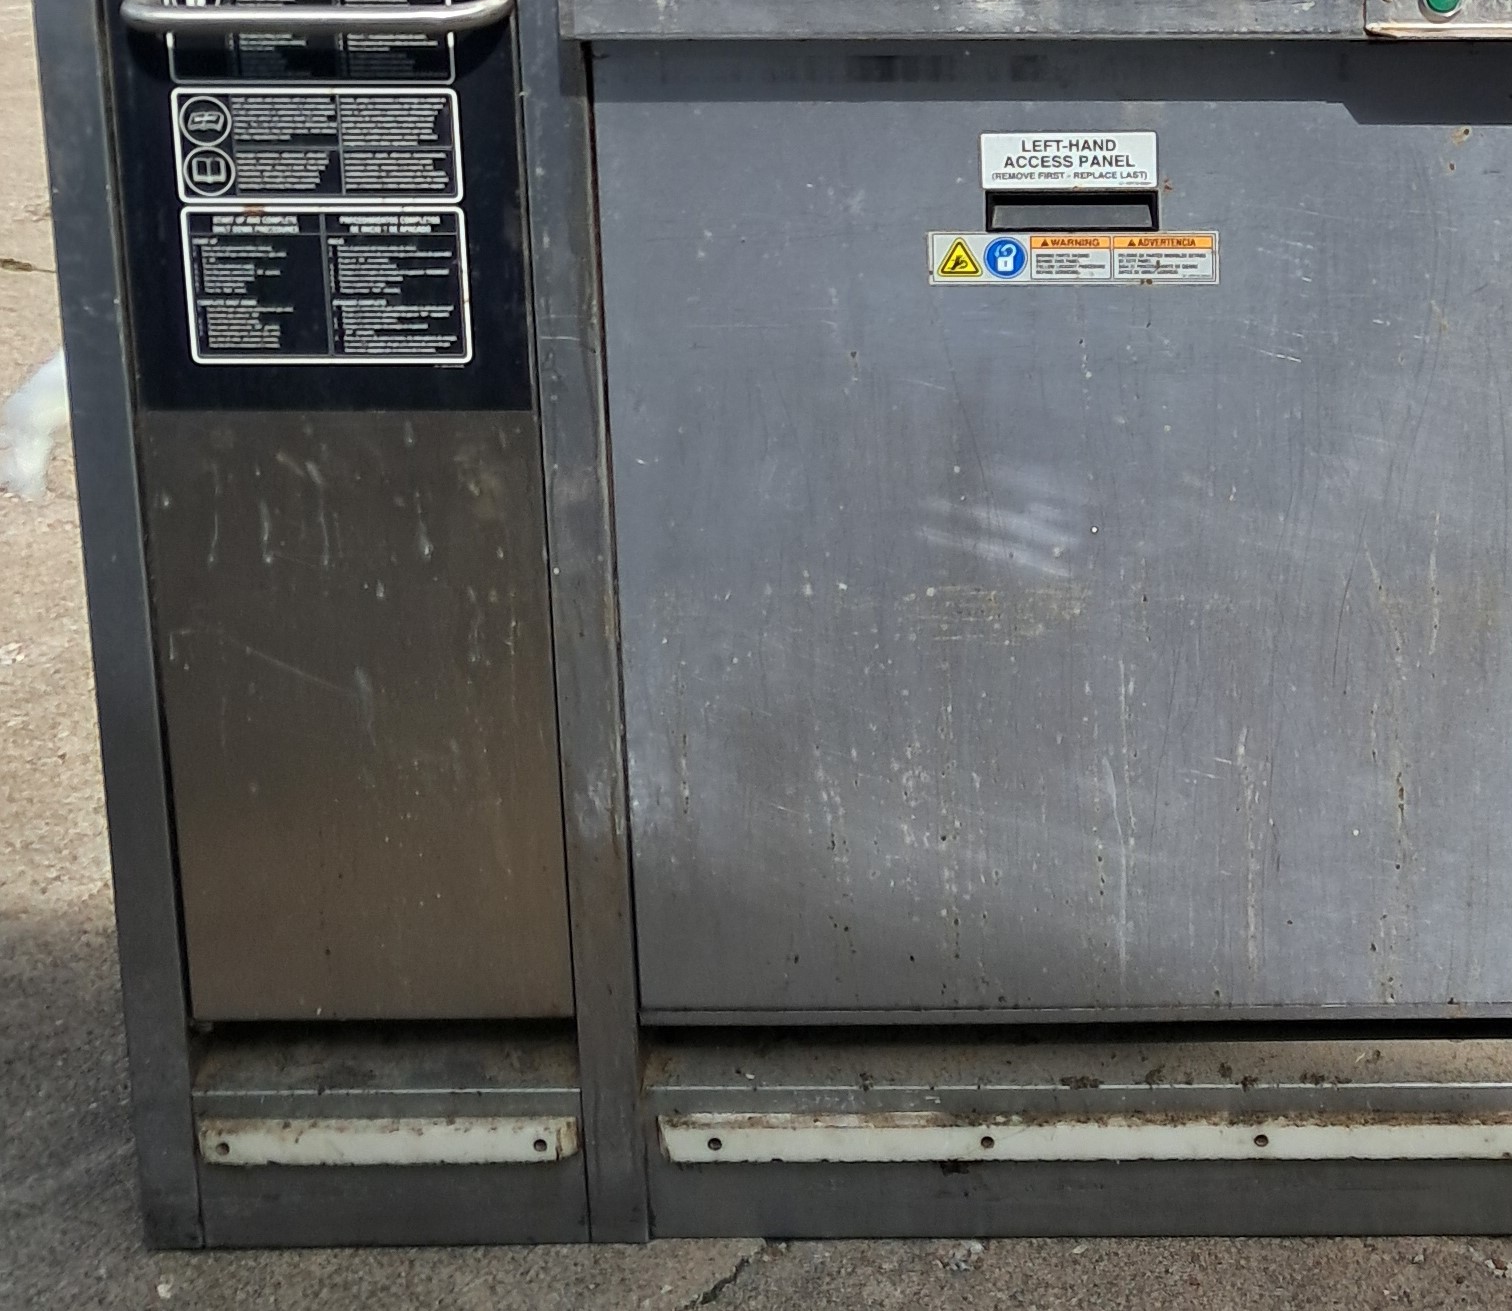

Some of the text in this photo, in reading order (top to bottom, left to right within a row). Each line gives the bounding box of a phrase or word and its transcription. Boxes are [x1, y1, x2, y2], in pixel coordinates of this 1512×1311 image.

[1021, 139, 1117, 152] LEFT-HAND
[1004, 154, 1135, 169] ACCESS PANEL
[991, 172, 1036, 181] (REMOVE
[1038, 172, 1065, 180] FIRST
[1073, 171, 1118, 180] REPLACE
[1120, 171, 1148, 180] LAST)
[1050, 238, 1100, 247] WARNING
[1137, 237, 1196, 247] ADVERTENCIA
